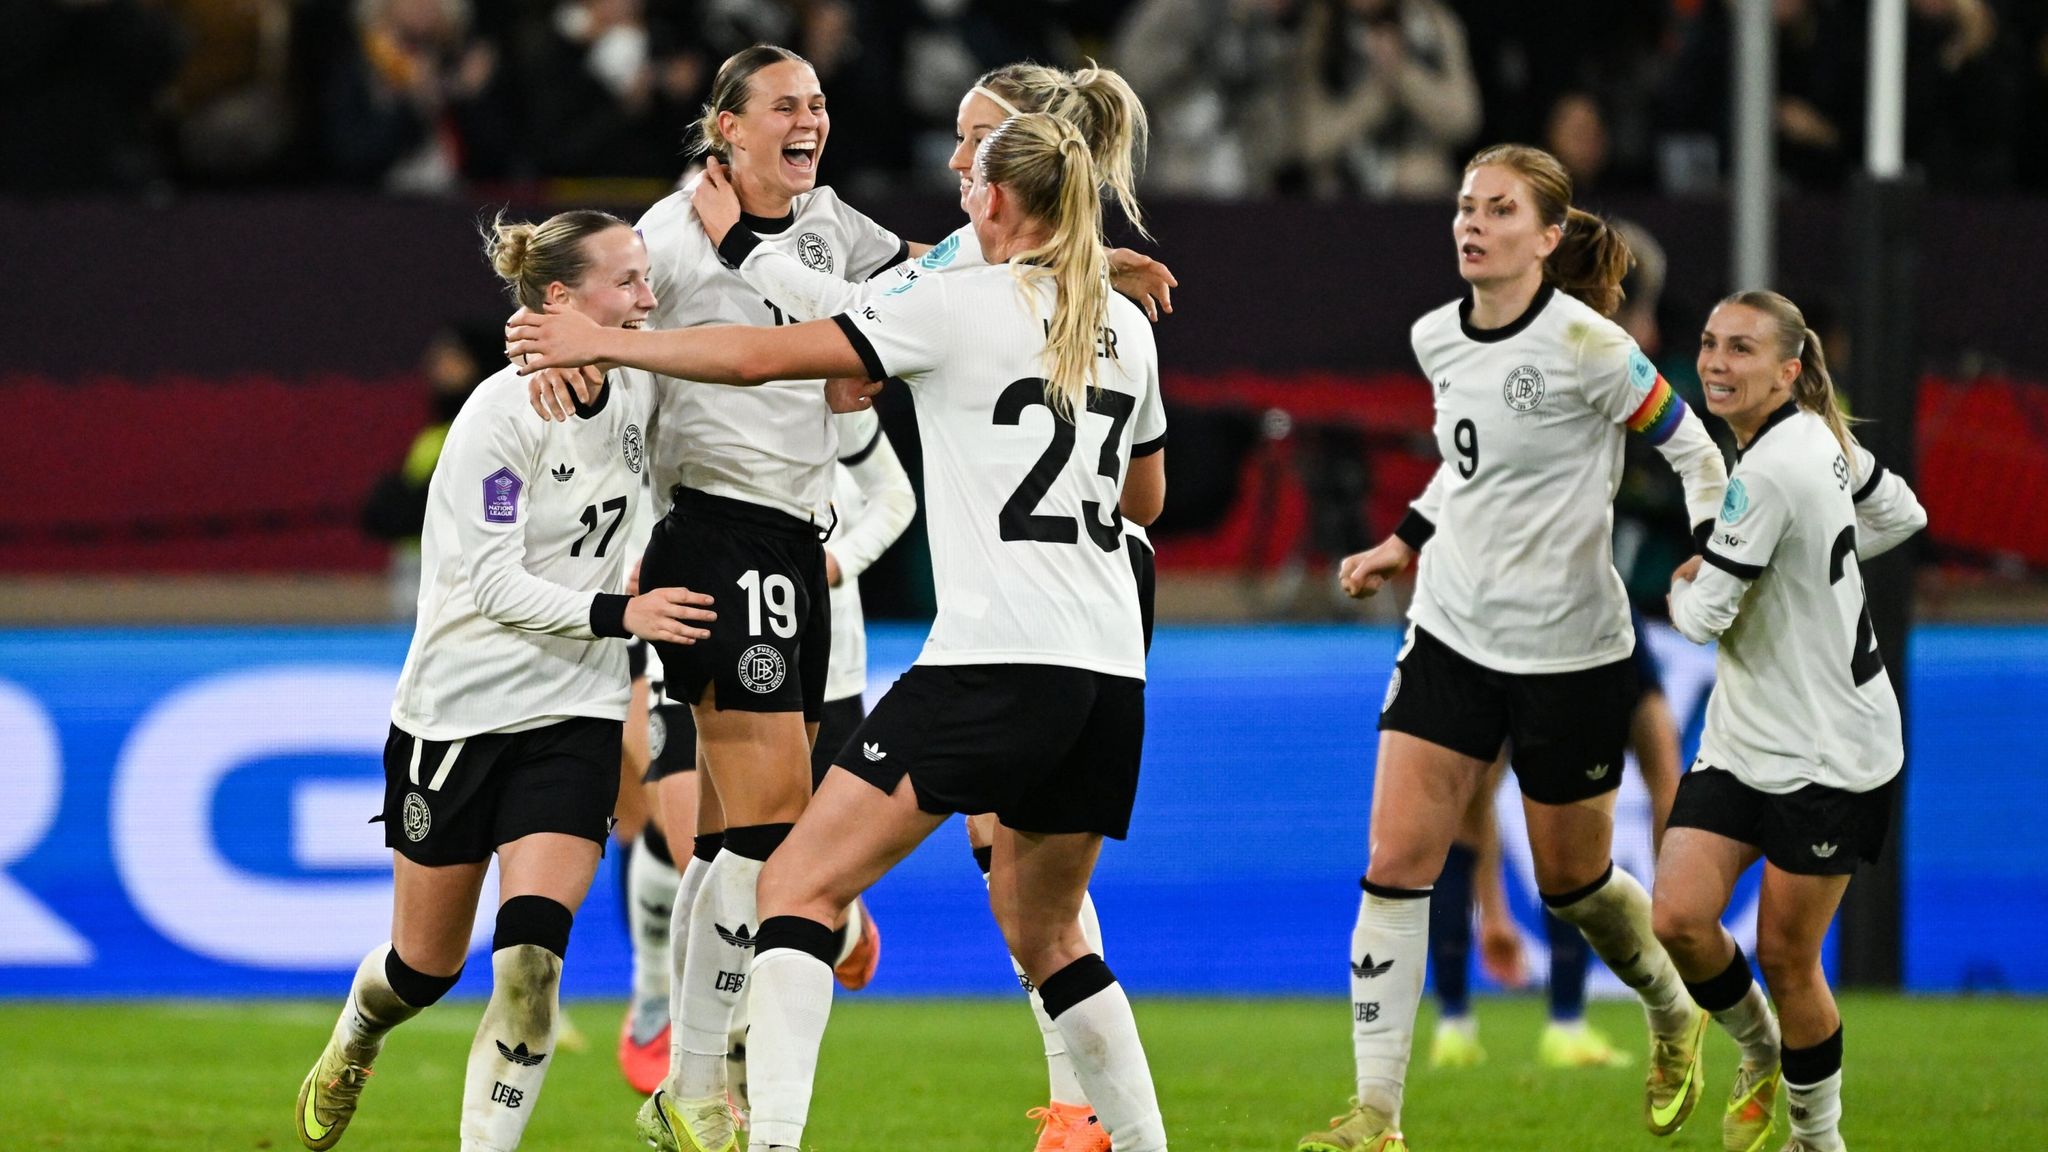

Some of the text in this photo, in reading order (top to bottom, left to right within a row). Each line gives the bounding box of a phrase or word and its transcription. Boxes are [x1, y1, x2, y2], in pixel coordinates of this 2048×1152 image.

[992, 377, 1136, 552] 23
[1454, 418, 1479, 480] 9
[570, 495, 627, 557] 17
[736, 569, 798, 639] 19
